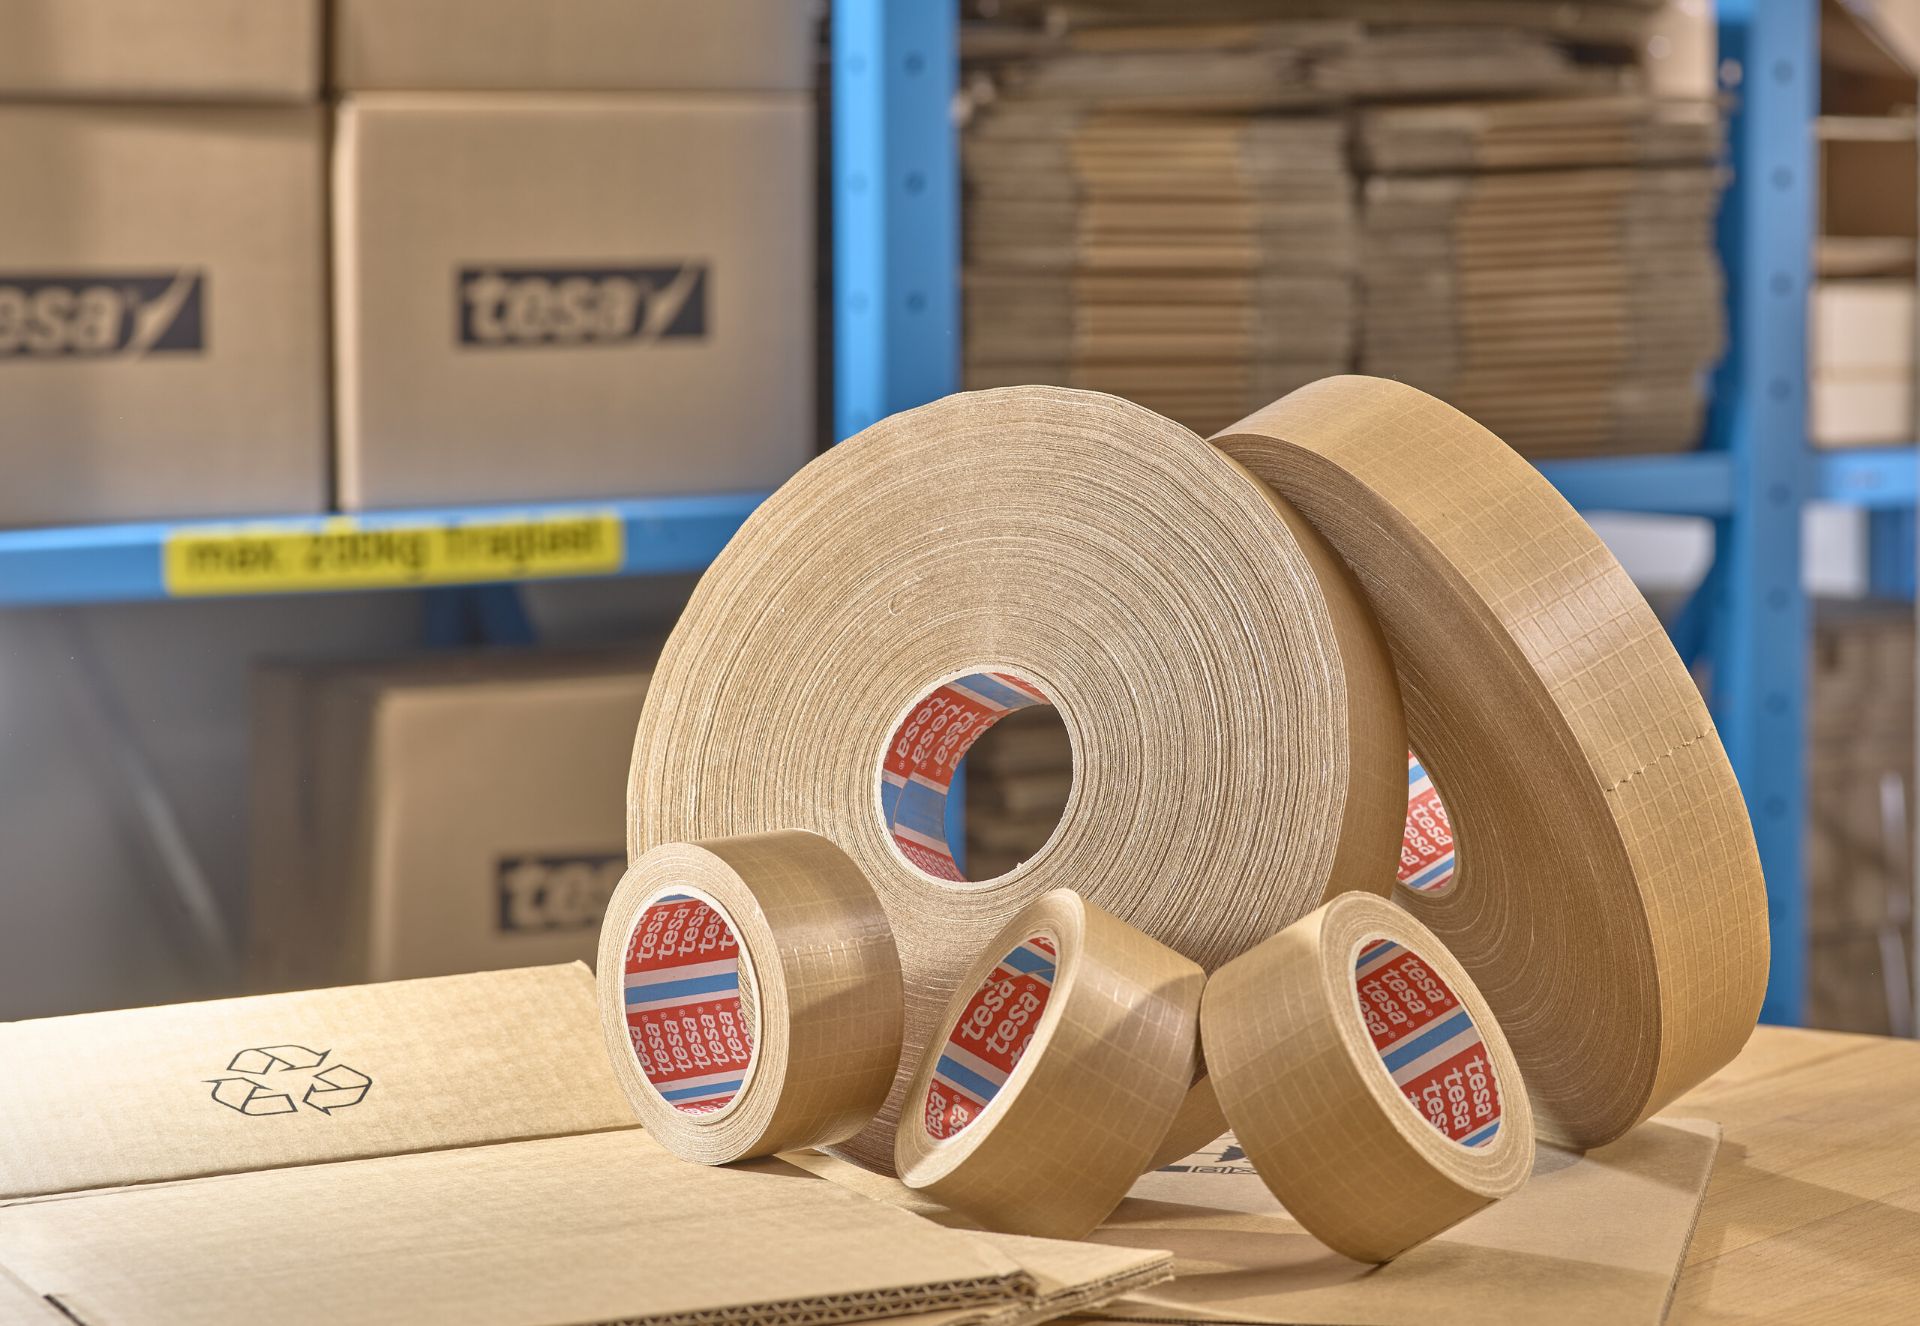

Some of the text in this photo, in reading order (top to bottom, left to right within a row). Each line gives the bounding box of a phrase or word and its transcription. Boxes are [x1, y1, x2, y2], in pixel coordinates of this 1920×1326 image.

[464, 268, 638, 342] tesa
[896, 697, 950, 759] tesa
[911, 704, 965, 764] tesa
[1411, 803, 1453, 846] tesa
[636, 911, 670, 963] tesa
[657, 908, 690, 960] tesa
[678, 905, 710, 957] tesa
[1362, 980, 1407, 1024] tesa
[1381, 968, 1426, 1014] tesa
[1400, 958, 1445, 1003] tesa
[961, 980, 1016, 1040] tesa
[986, 991, 1040, 1054] tesa
[645, 1022, 675, 1076] tesa
[664, 1020, 693, 1072] tesa
[682, 1017, 711, 1069] tesa
[701, 1014, 730, 1066] tesa
[719, 1011, 747, 1063] tesa
[1444, 1067, 1471, 1130] tesa
[1465, 1055, 1492, 1118] tesa
[926, 1091, 947, 1137] tesa
